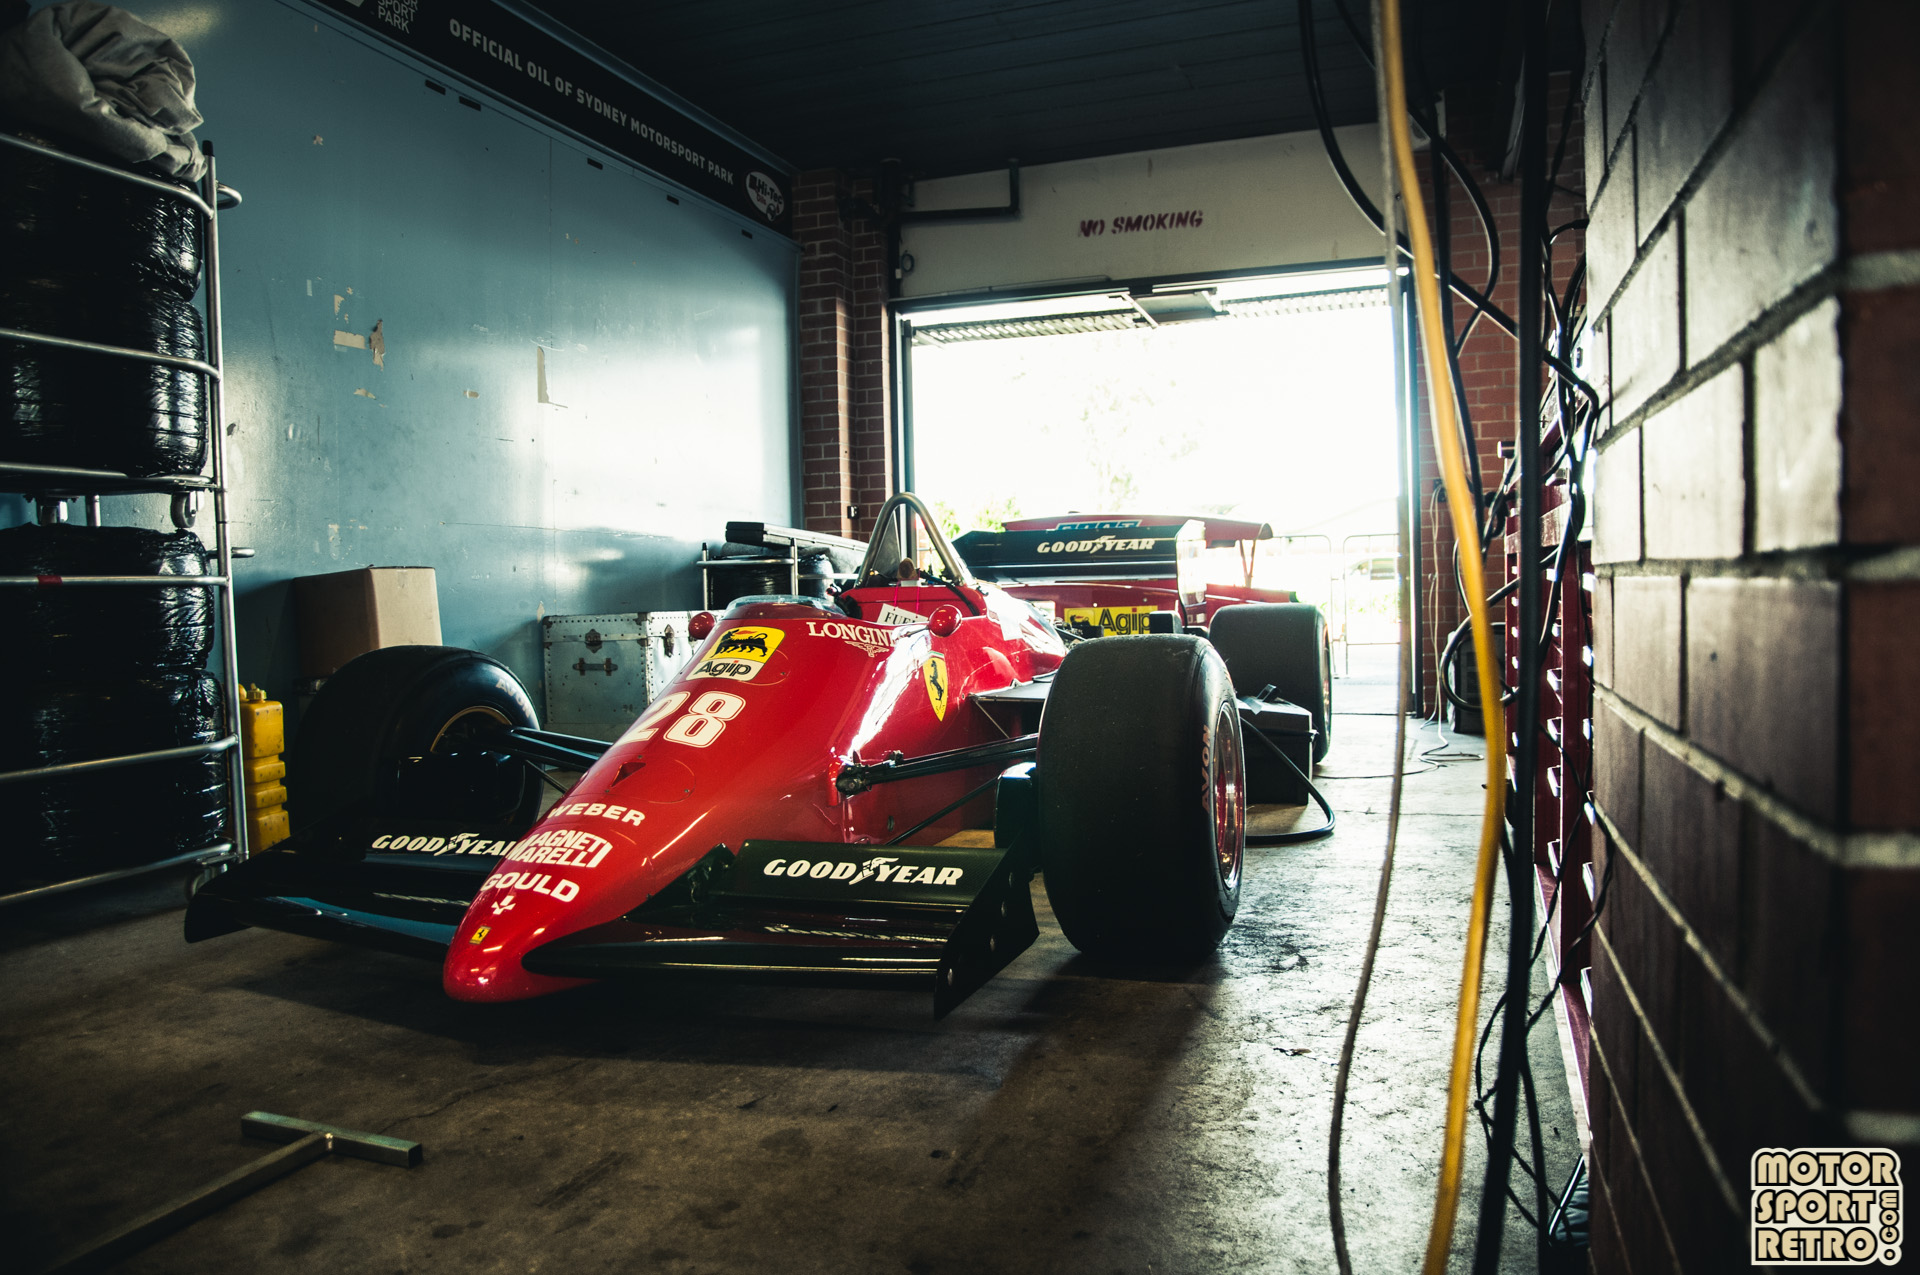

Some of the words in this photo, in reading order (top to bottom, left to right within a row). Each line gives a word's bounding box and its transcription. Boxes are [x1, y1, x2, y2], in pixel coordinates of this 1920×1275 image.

[378, 5, 410, 34] PARK
[449, 18, 523, 72] OFFICIAL
[526, 61, 551, 87] OIL
[554, 76, 573, 97] OF
[576, 88, 627, 127] SYDNEY
[630, 117, 706, 169] MOTORSPORT
[707, 160, 734, 186] PARK
[1078, 219, 1106, 238] NO
[1111, 209, 1204, 235] SMOKING
[884, 611, 917, 625] FUE
[1100, 607, 1151, 636] Agip
[692, 659, 752, 677] Agip
[610, 690, 747, 749] 28
[1201, 723, 1212, 815] AVON
[546, 802, 646, 827] WEBER
[480, 871, 580, 903] GOULD
